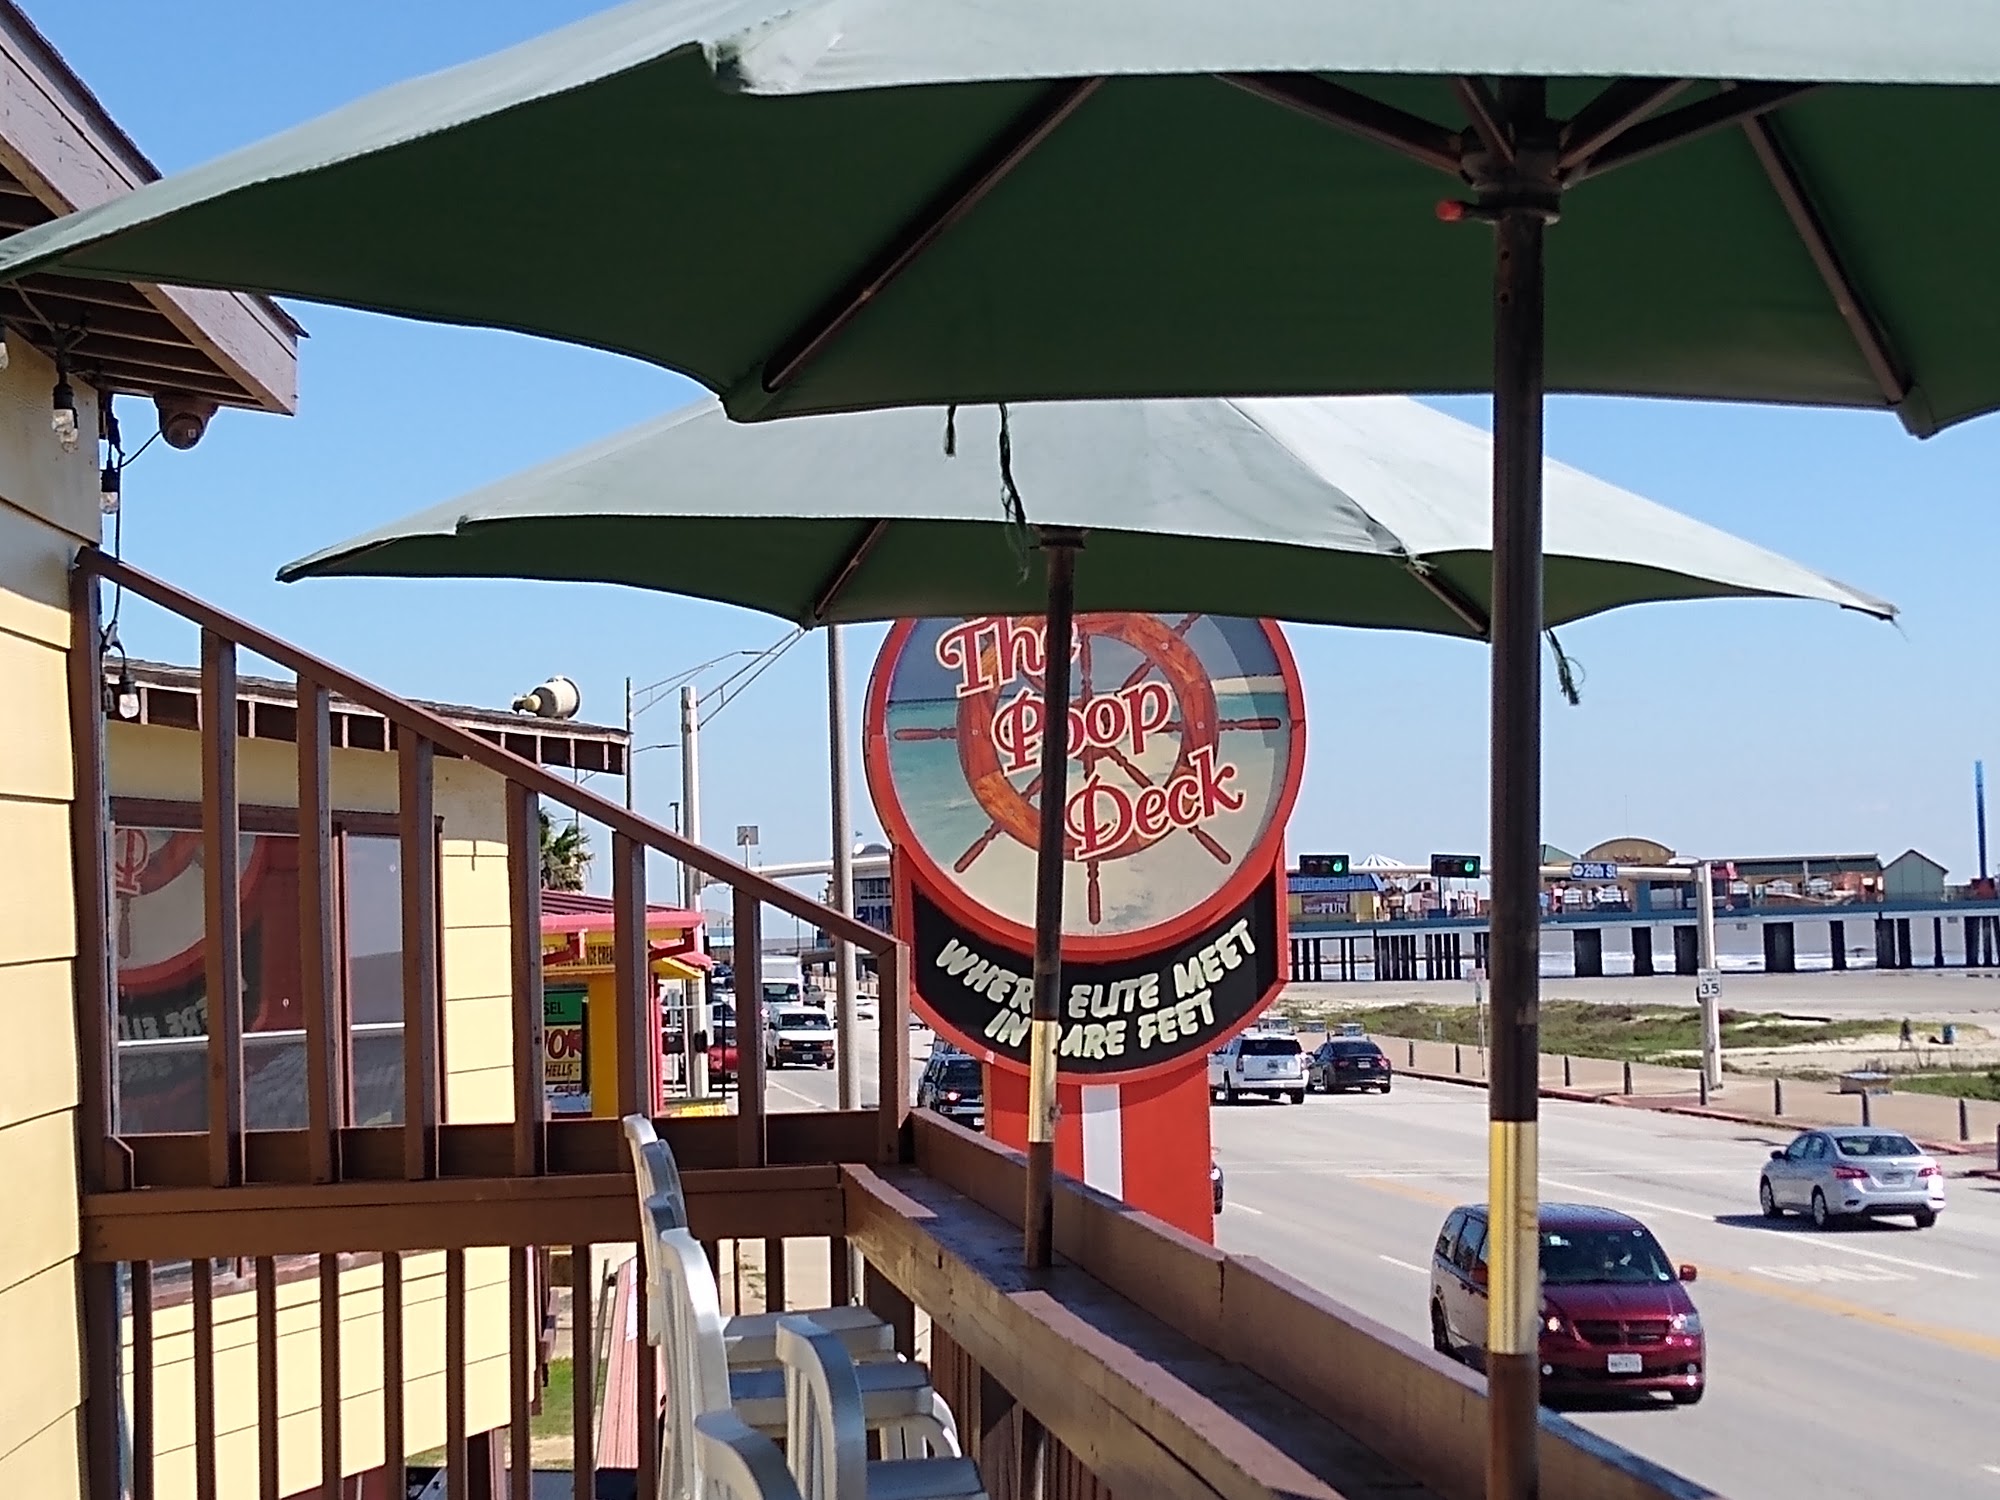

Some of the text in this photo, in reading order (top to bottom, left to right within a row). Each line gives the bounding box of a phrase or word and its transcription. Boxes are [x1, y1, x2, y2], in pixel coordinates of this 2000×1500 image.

[1065, 745, 1247, 861] Deck
[935, 917, 1256, 1019] WHER ELITE MEET
[1701, 983, 1719, 994] 35
[544, 1001, 565, 1015] SEL
[984, 988, 1214, 1059] IN ARE FEET
[545, 1063, 573, 1077] HELLS
